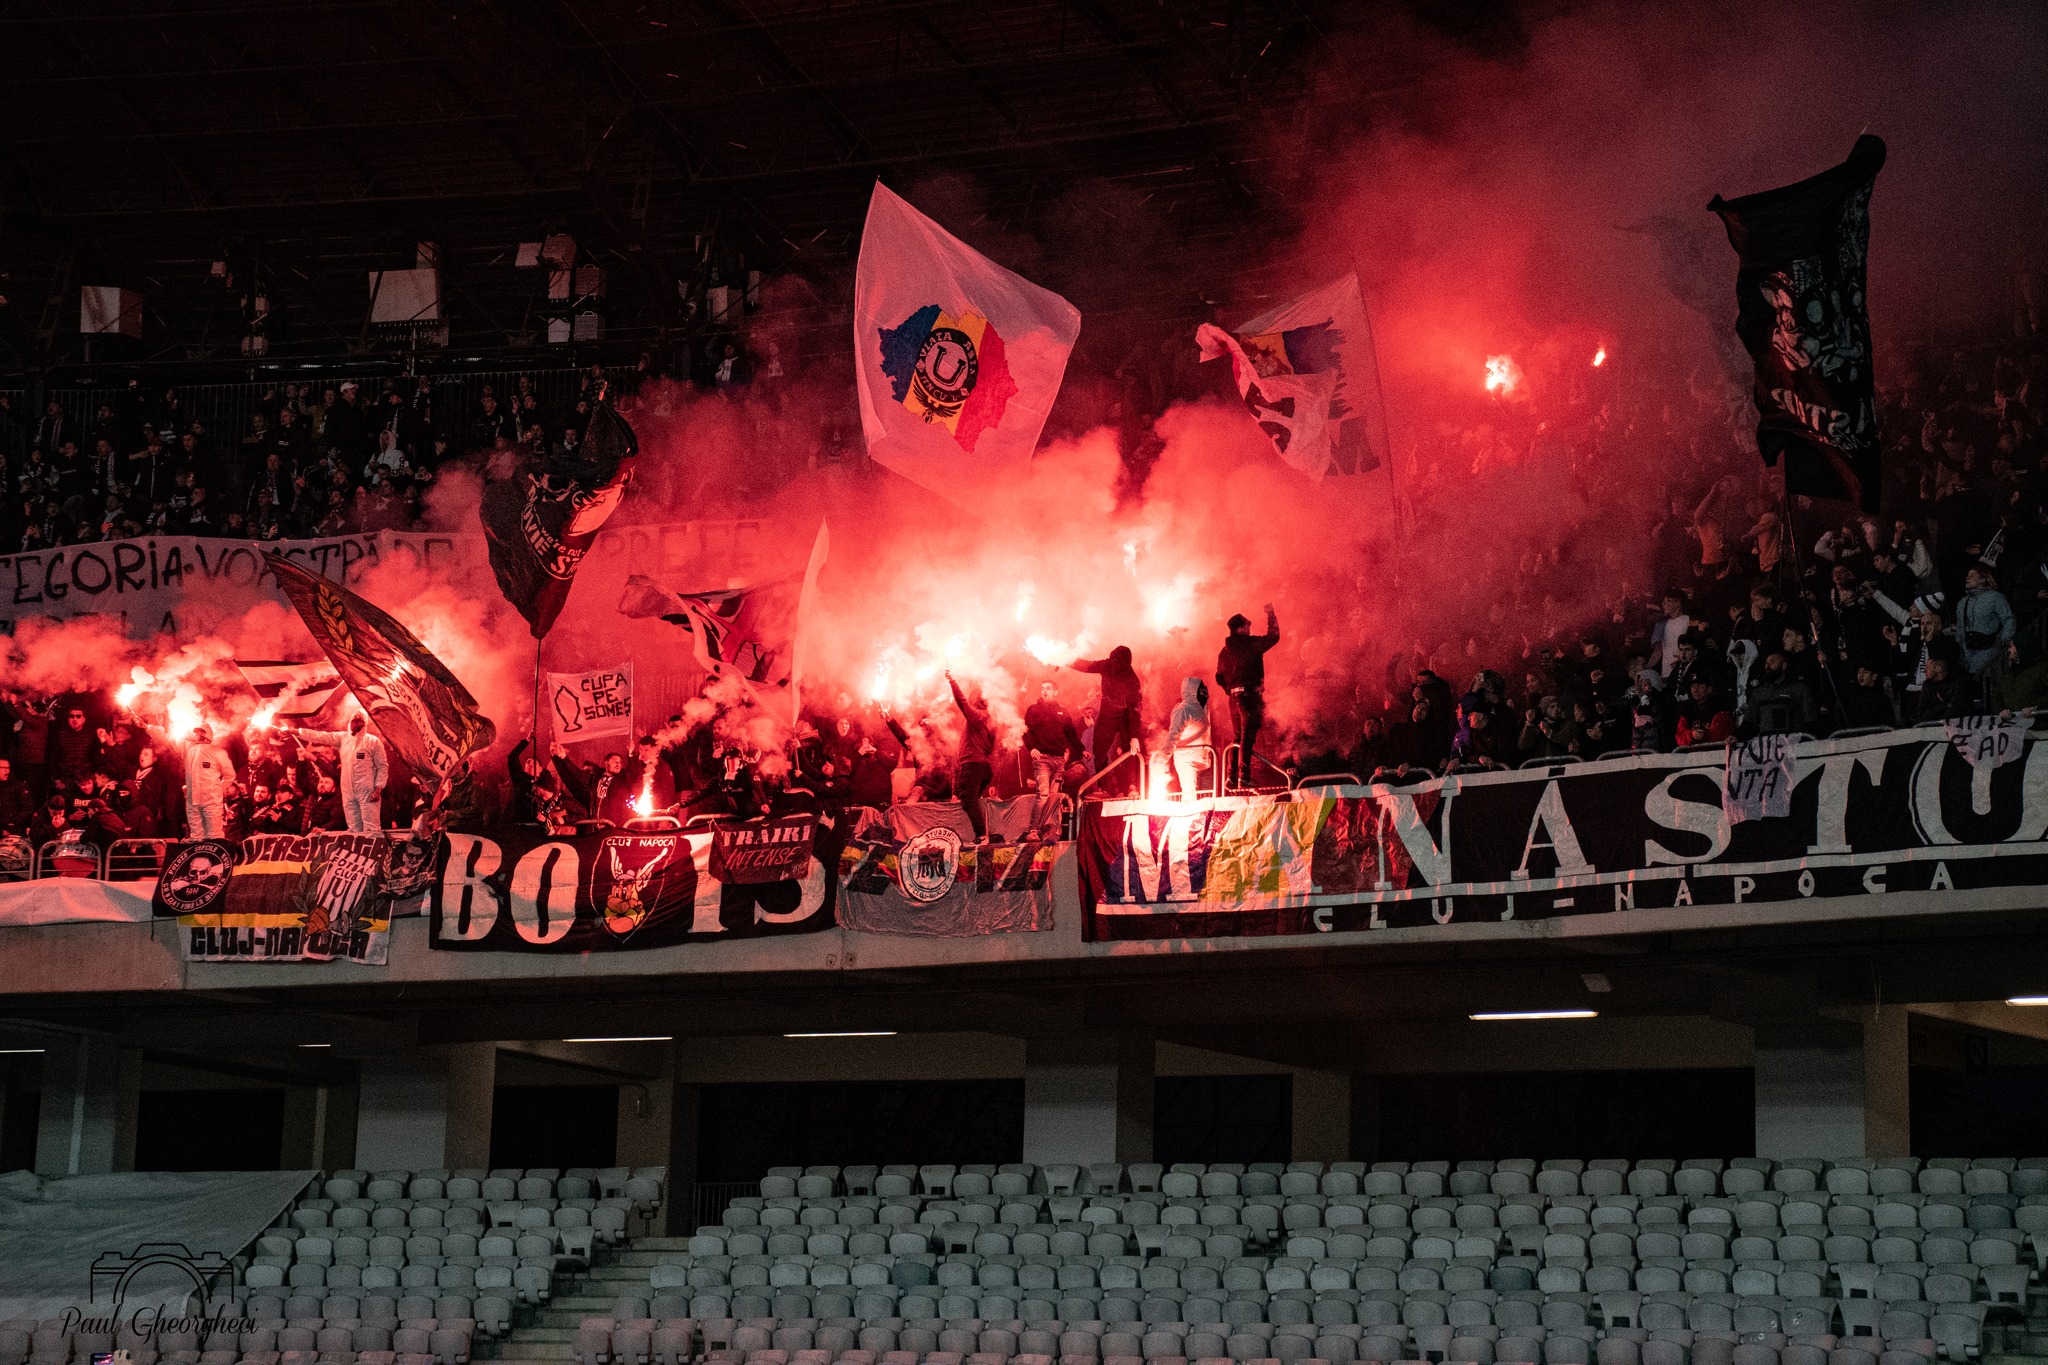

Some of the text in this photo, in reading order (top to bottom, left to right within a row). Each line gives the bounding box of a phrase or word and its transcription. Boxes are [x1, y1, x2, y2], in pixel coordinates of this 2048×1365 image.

[933, 345, 966, 387] U
[580, 672, 628, 693] CUPA
[592, 687, 619, 705] PE
[606, 838, 675, 848] CLUJ NAPOCA
[721, 823, 813, 847] TRĂIRI
[725, 846, 802, 870] INTENSE
[334, 867, 359, 881] CLUB
